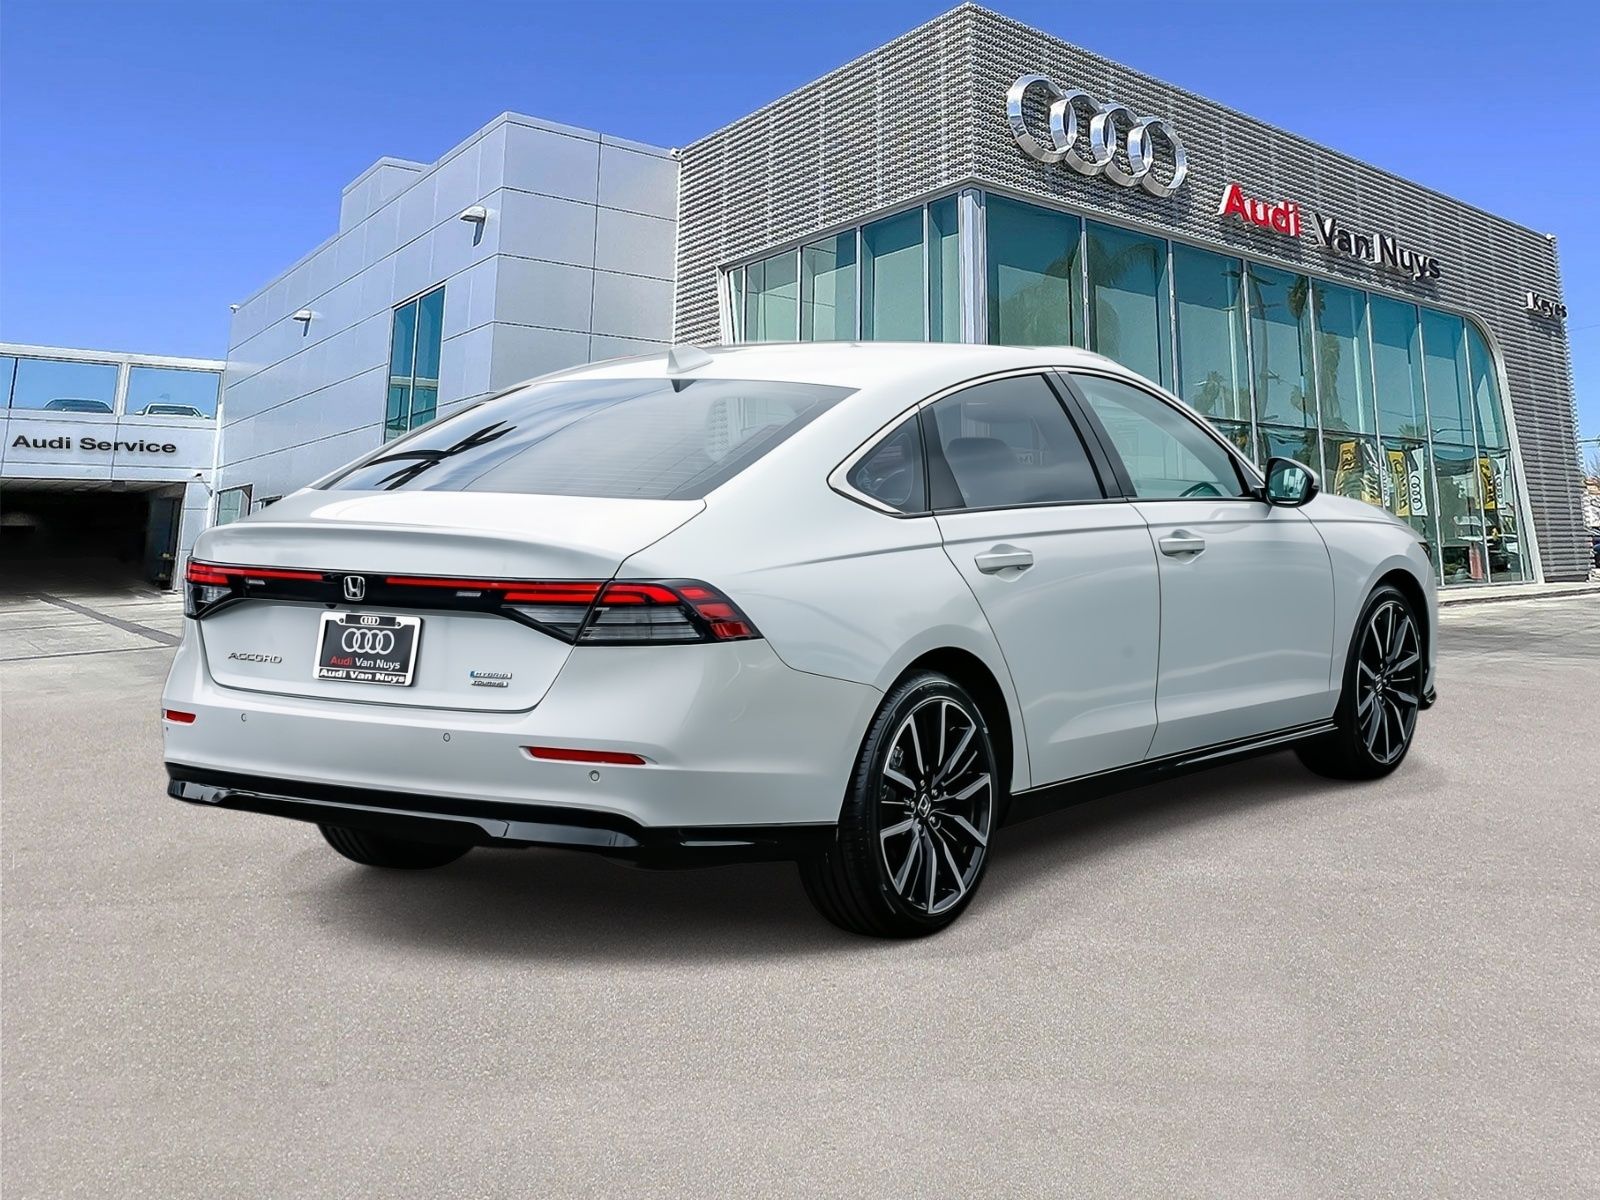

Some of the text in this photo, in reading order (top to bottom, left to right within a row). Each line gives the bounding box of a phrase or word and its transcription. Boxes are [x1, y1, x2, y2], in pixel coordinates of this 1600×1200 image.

[1217, 182, 1441, 280] Audi Van Nuys
[12, 435, 177, 454] Audi Service
[227, 652, 283, 664] ACCORD
[330, 655, 400, 671] Audi Van Nuys
[319, 668, 405, 684] Audi Van Nuys
